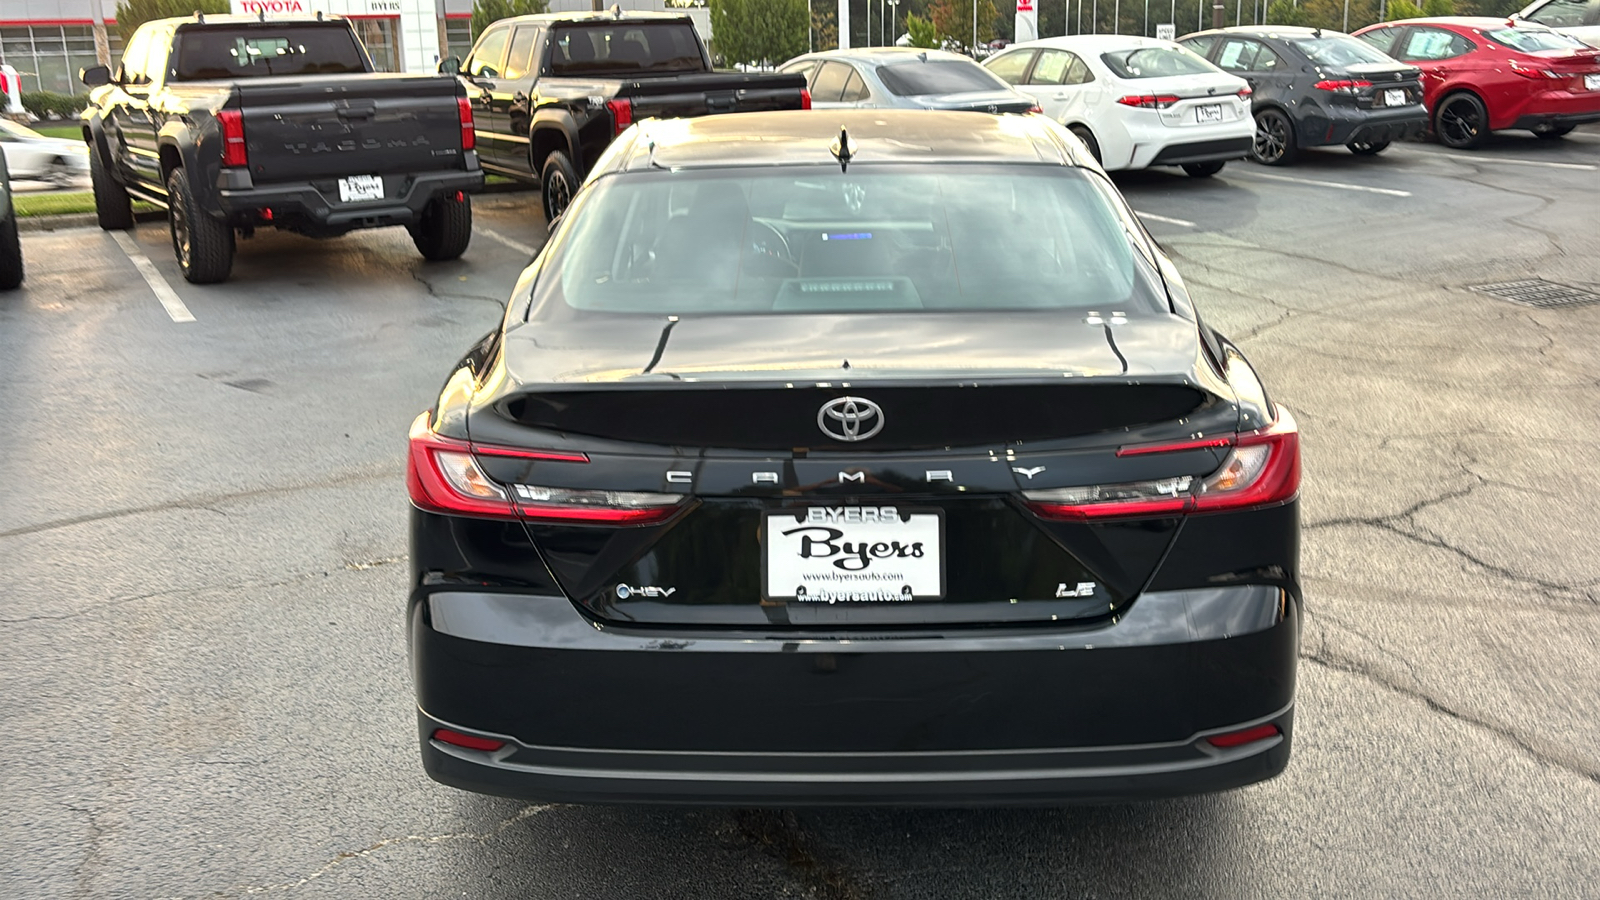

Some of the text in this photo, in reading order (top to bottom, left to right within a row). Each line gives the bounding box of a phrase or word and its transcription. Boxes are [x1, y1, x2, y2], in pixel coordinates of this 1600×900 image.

[240, 0, 303, 13] TOYOTA
[371, 1, 400, 11] BYERS
[284, 135, 430, 154] TACOMA
[665, 465, 1047, 484] CAMRY
[806, 506, 899, 525] BYERS
[781, 526, 925, 571] Byers
[802, 570, 905, 583] www.byersauto.com
[796, 586, 914, 605] www.byersauto.com
[1055, 582, 1097, 598] LE
